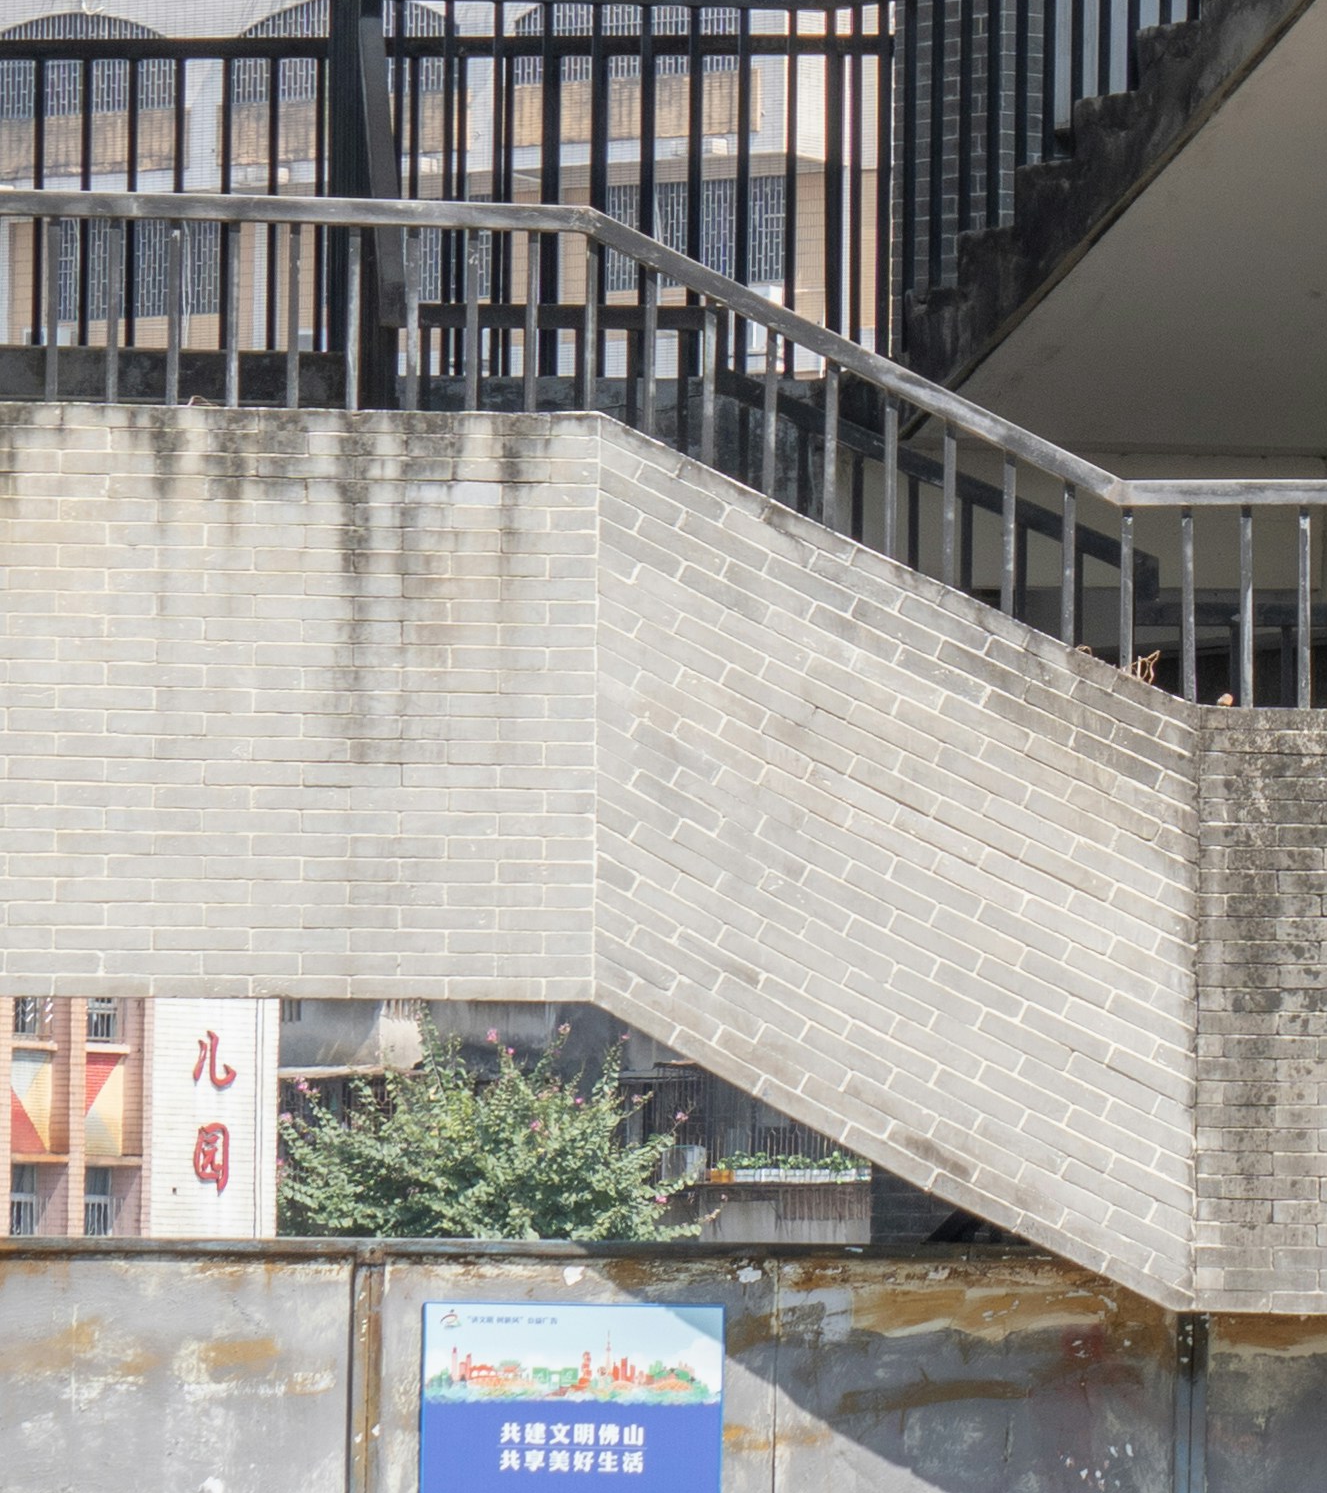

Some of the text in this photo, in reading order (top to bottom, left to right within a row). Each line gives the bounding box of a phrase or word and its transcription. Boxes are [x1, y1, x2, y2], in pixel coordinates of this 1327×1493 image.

[500, 1422, 645, 1446] 共建文明佛山
[499, 1449, 644, 1473] 共享美好生活
